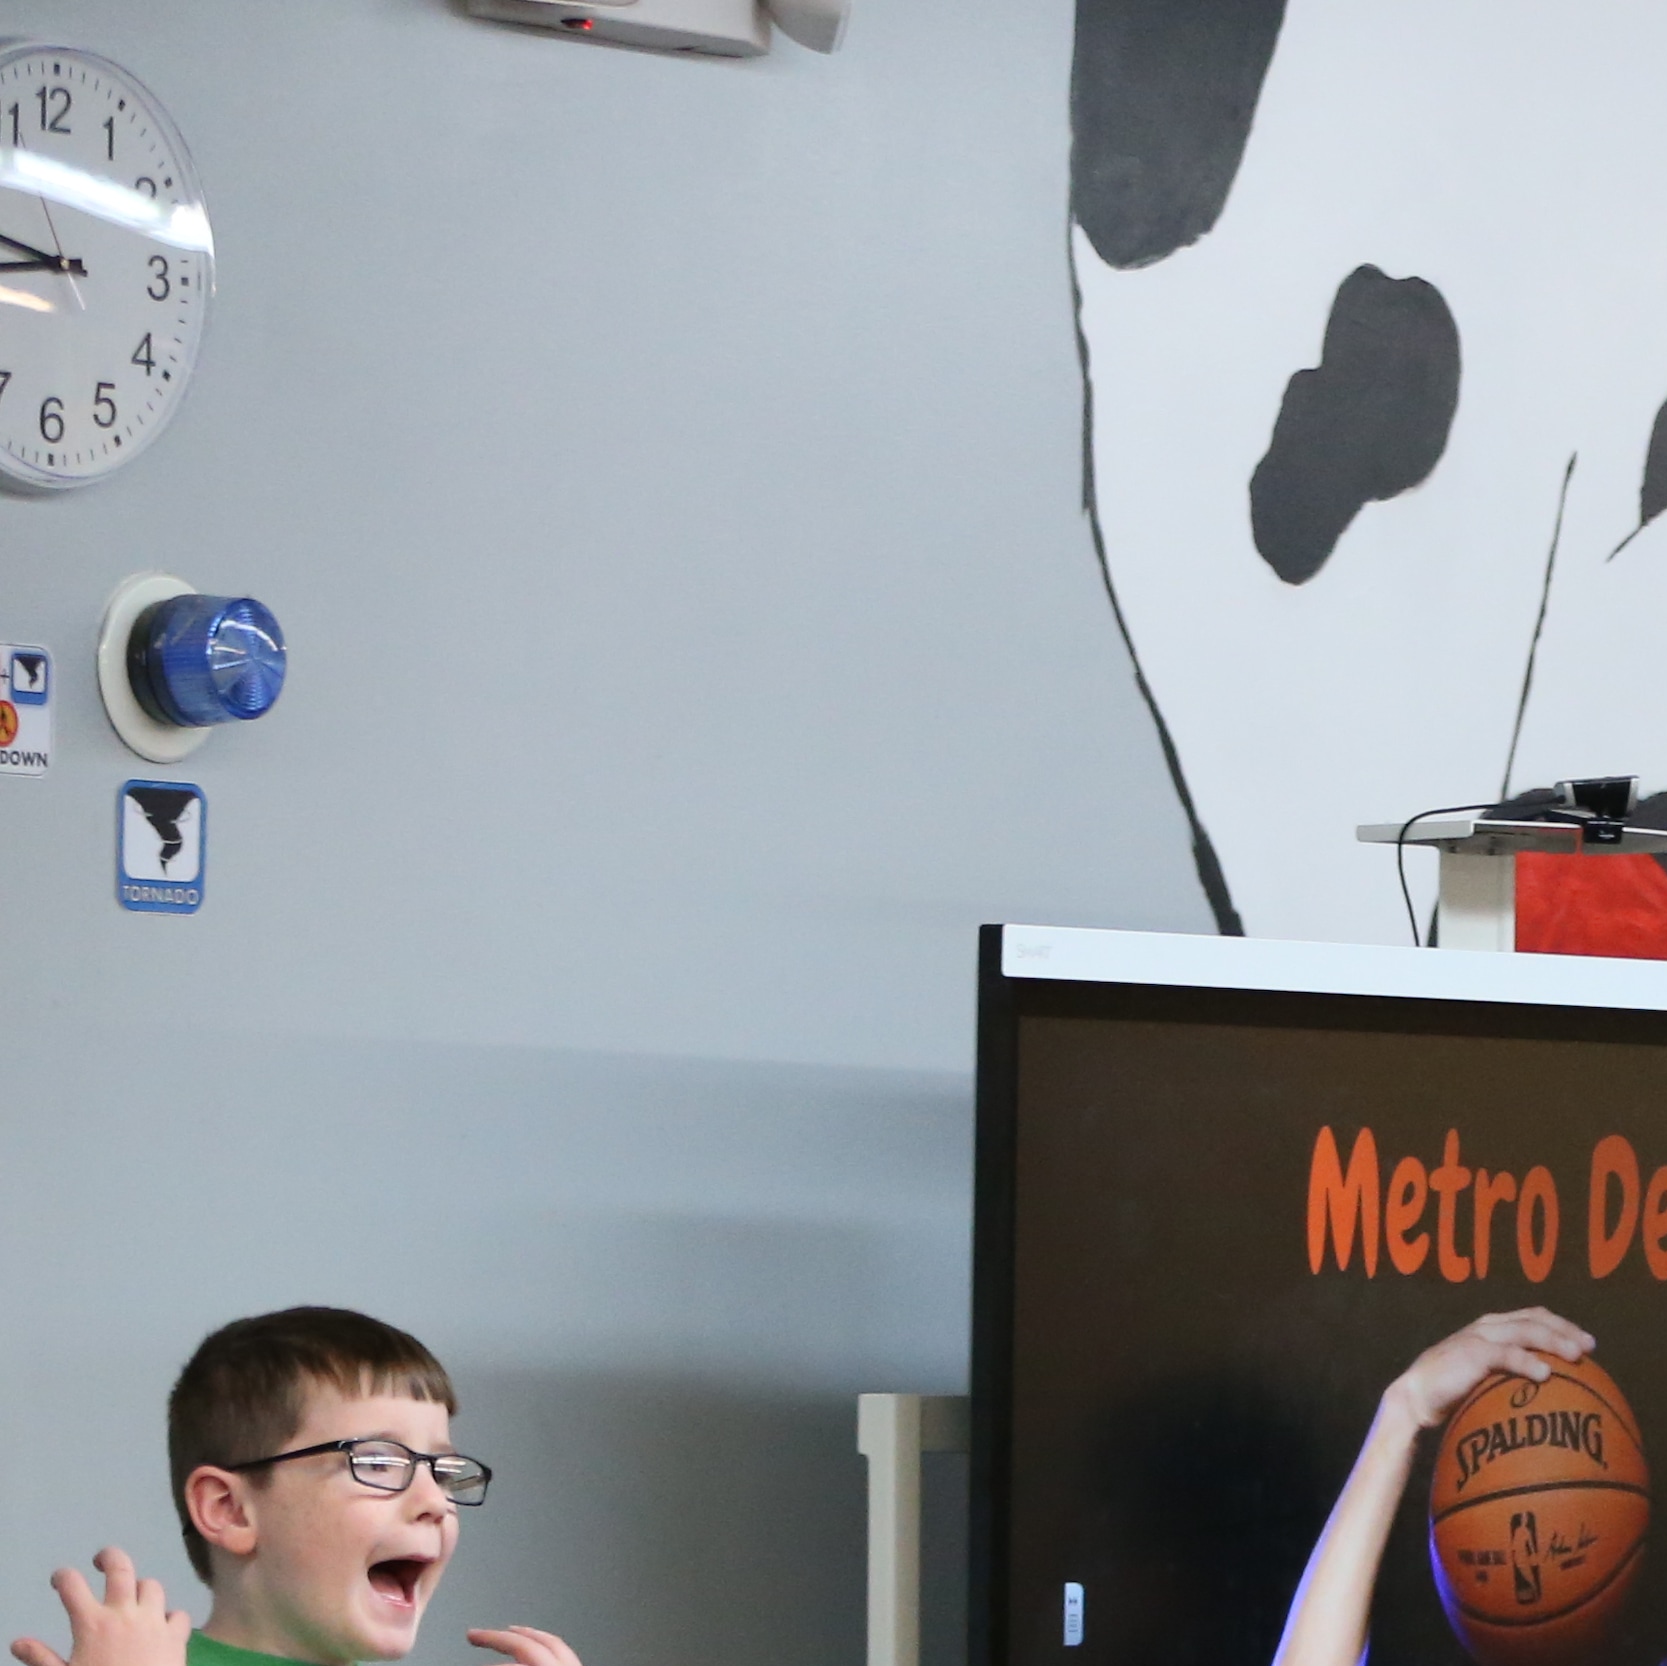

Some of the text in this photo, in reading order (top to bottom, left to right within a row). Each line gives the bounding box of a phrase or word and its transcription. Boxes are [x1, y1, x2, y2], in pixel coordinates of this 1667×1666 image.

[36, 86, 72, 134] 12
[103, 116, 114, 161] 1
[147, 254, 170, 302] 3
[130, 332, 156, 377] 4
[39, 396, 64, 444] 6
[93, 382, 116, 428] 5
[123, 884, 199, 906] TORNADO
[1306, 1125, 1560, 1285] Metro
[1455, 1411, 1608, 1494] SPALDING
